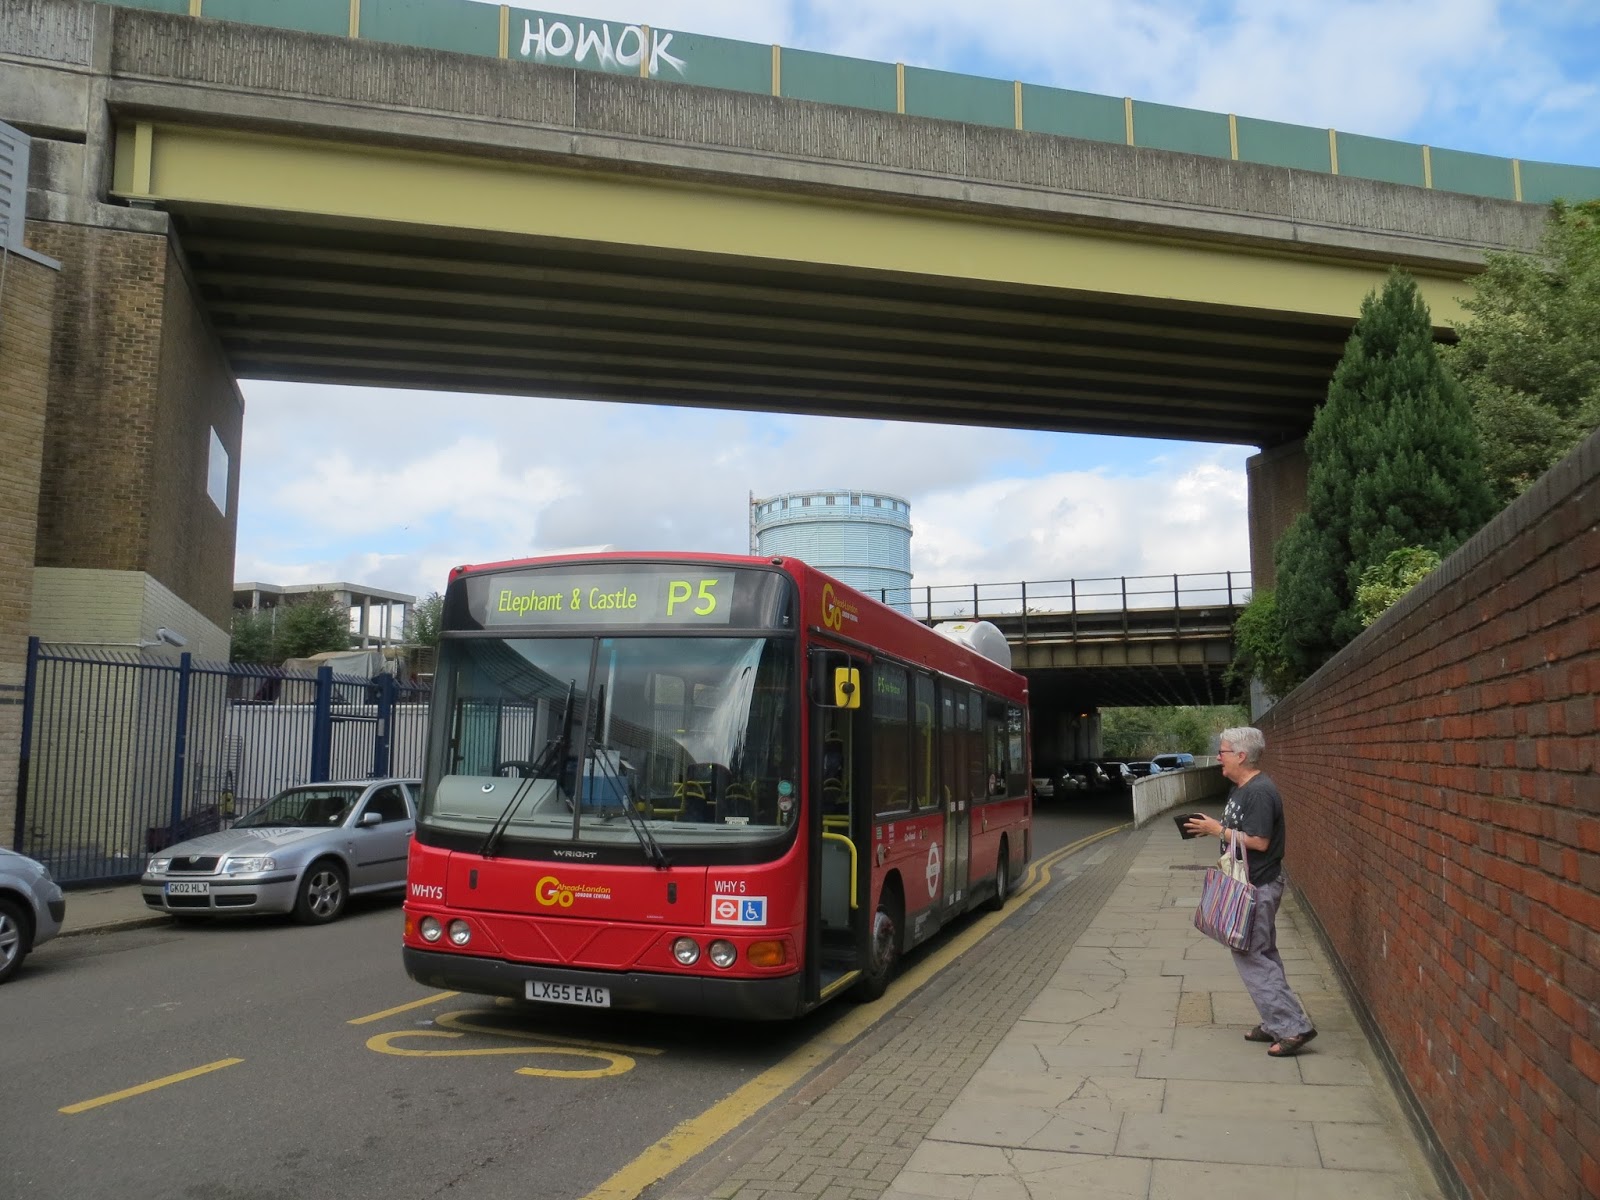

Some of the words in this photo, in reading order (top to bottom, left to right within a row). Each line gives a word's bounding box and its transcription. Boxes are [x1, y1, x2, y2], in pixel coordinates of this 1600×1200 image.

[498, 589, 563, 617] Elephant
[570, 588, 582, 610] &
[589, 587, 637, 610] Castle
[666, 579, 719, 617] P5
[553, 849, 597, 858] WRIGHT
[169, 883, 190, 893] GK02
[191, 883, 208, 893] HLX
[411, 882, 443, 900] WHY5
[535, 875, 574, 908] Go
[557, 883, 611, 893] Ahead-London
[714, 880, 738, 893] WHY
[739, 880, 746, 893] 5
[531, 980, 571, 1001] LX55
[575, 986, 604, 1004] EAG
